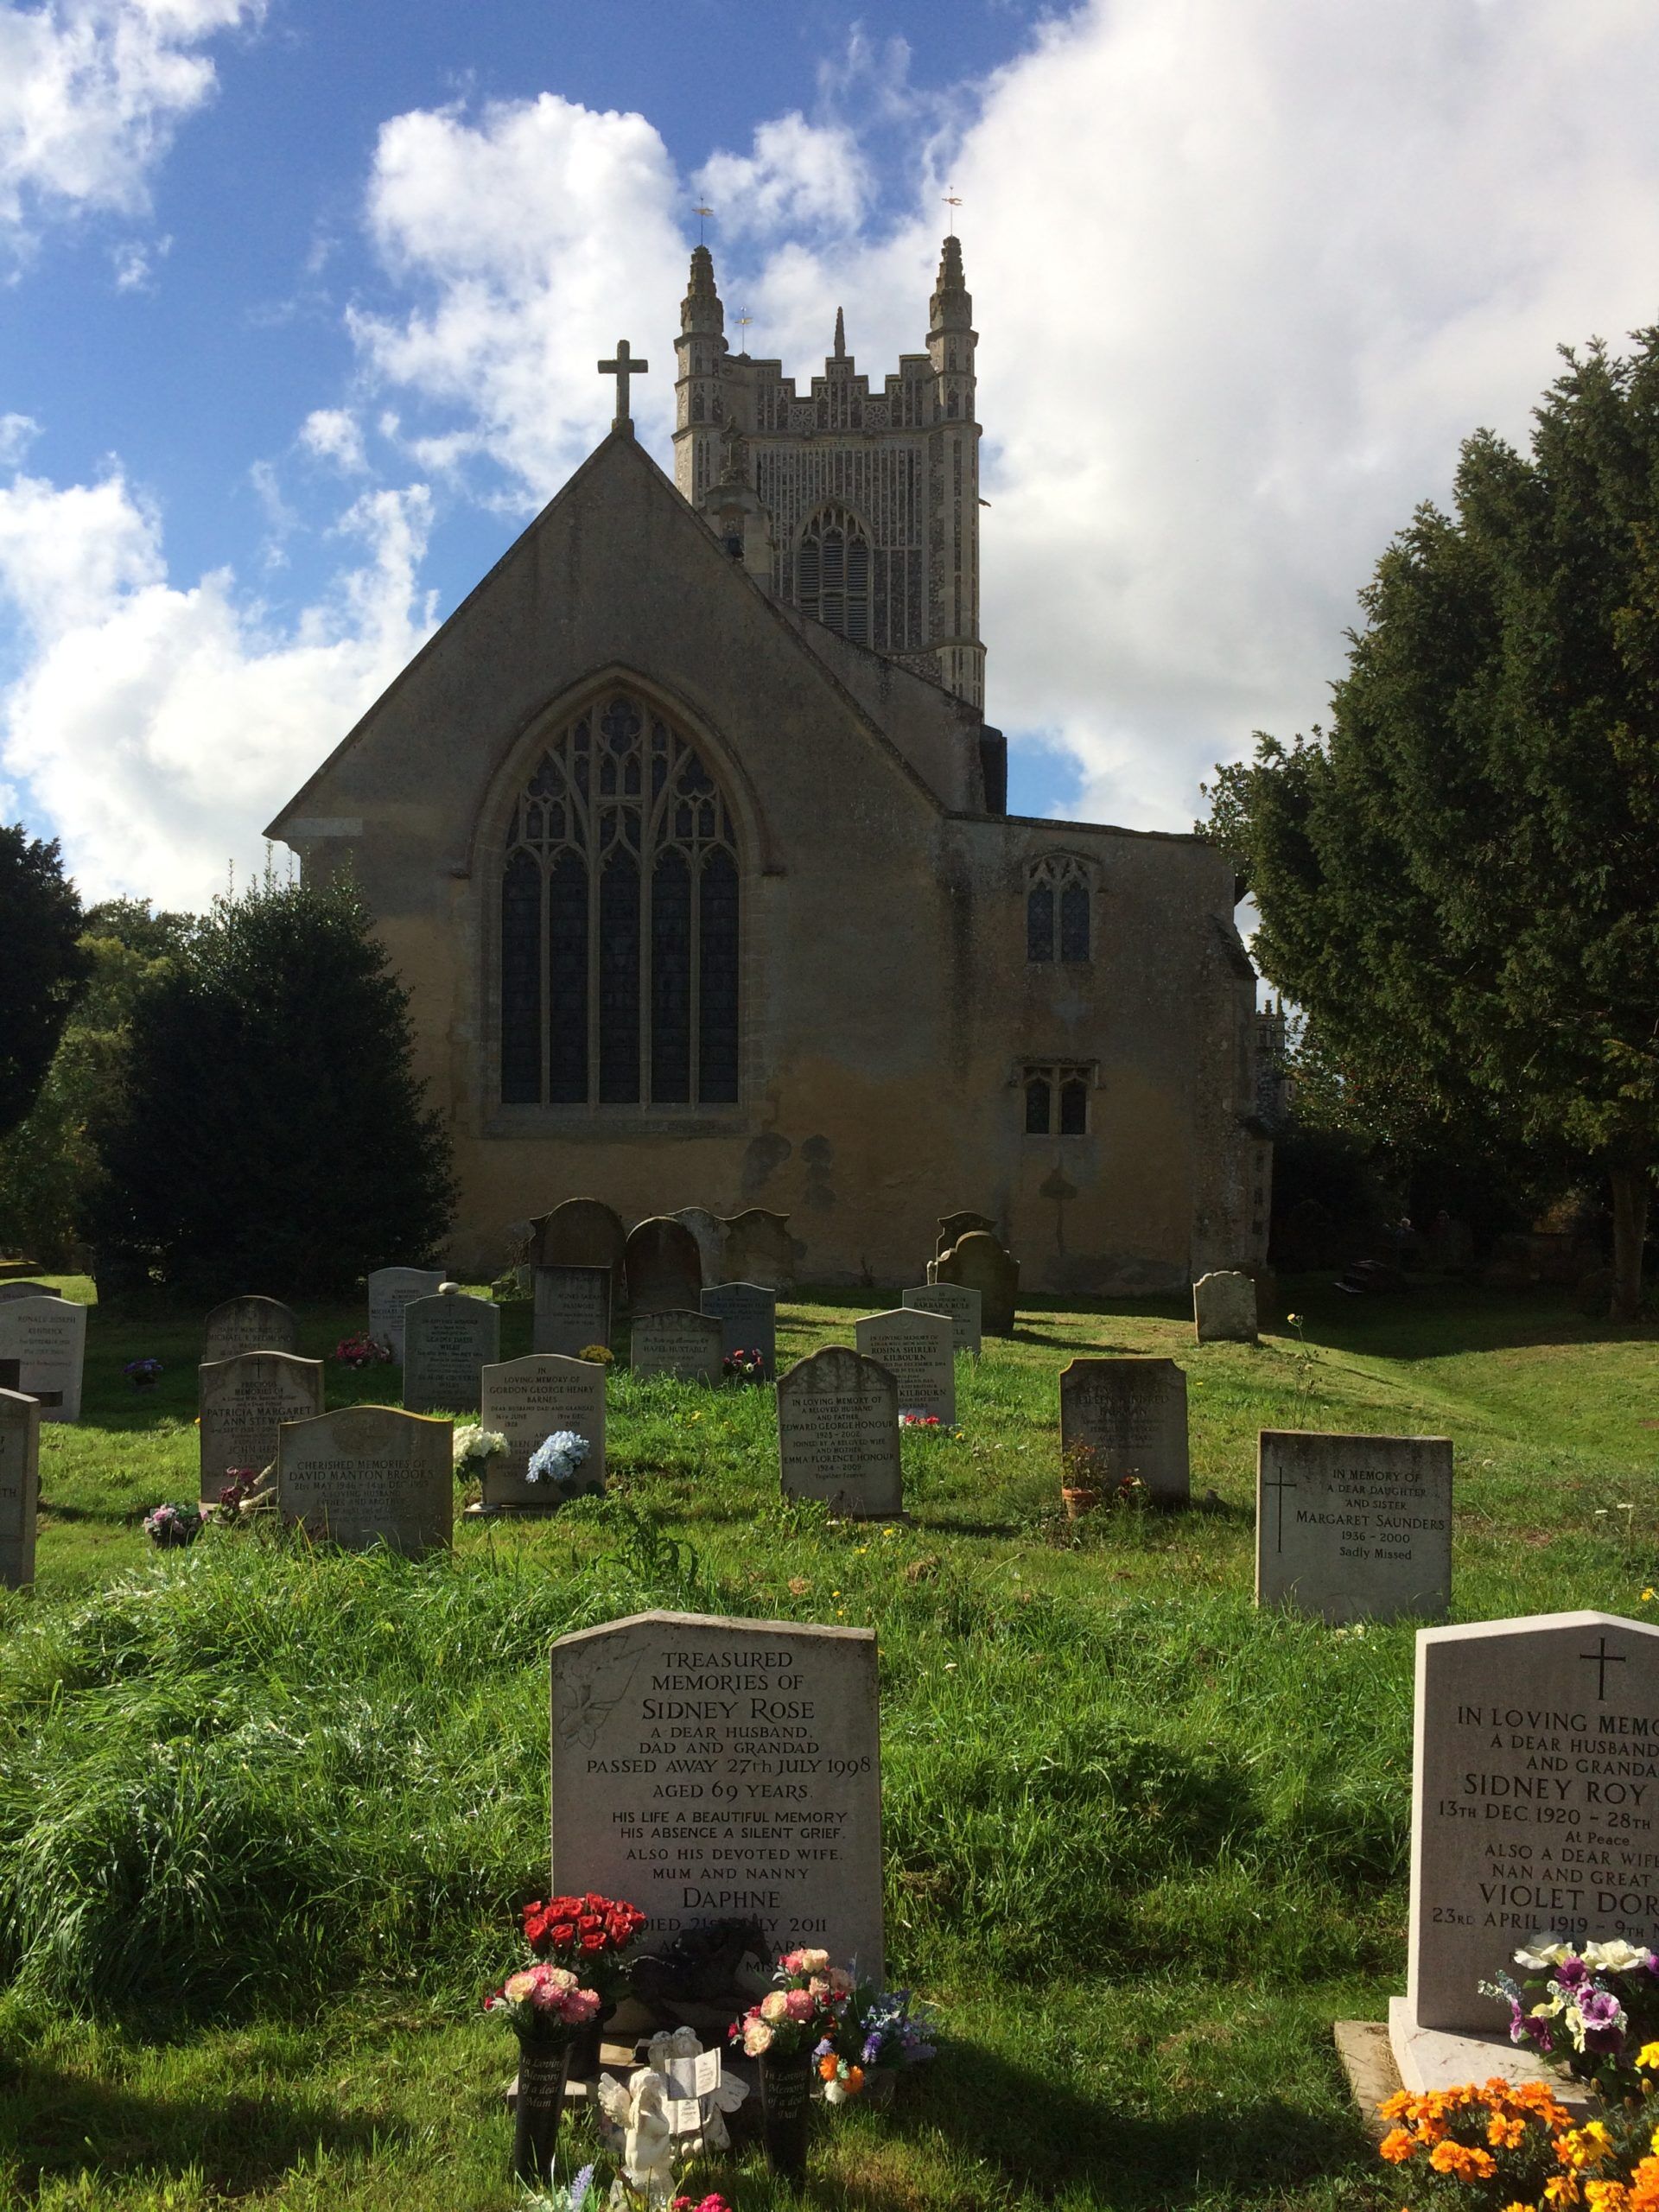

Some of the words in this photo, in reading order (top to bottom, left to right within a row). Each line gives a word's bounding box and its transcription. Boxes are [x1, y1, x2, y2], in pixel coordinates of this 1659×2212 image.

[207, 1408, 252, 1417] PATRICIA
[257, 1406, 311, 1415] MARGARET
[297, 1460, 353, 1471] CHERISHED
[358, 1460, 410, 1469] MEMORIES
[289, 1471, 326, 1481] DAVID
[330, 1470, 383, 1480] MANTON
[1333, 1469, 1344, 1479] IN
[1350, 1471, 1401, 1482] MEMORY
[1405, 1472, 1421, 1483] OF
[1338, 1484, 1366, 1494] DEAR
[1370, 1486, 1426, 1497] DAUGHTER
[1346, 1499, 1370, 1508] AND
[1372, 1500, 1407, 1510] SISTER
[1296, 1510, 1370, 1526] MARGARET
[1376, 1515, 1445, 1530] SAUNDERS
[1342, 1530, 1365, 1541] 1936
[1380, 1533, 1410, 1543] 2000
[1339, 1547, 1370, 1560] Sadly
[1375, 1548, 1412, 1560] Missed
[662, 1652, 792, 1672] TREASURED
[652, 1675, 769, 1695] MEMORIES
[778, 1675, 804, 1690] OF
[642, 1699, 739, 1720] SIDNEY
[750, 1698, 814, 1724] ROSE
[1458, 1706, 1481, 1726] IN
[1491, 1708, 1587, 1732] LOVING
[651, 1726, 662, 1738] A
[671, 1726, 719, 1741] DEAR
[1490, 1733, 1503, 1749] A
[1511, 1735, 1561, 1751] DEAR
[639, 1742, 677, 1754] DAD
[685, 1742, 723, 1754] AND
[734, 1742, 819, 1758] GRANDAD
[587, 1759, 657, 1774] PASSED
[665, 1759, 719, 1774] AWAY
[774, 1759, 822, 1777] JULY
[827, 1757, 871, 1778] 1998
[1526, 1755, 1568, 1771] AND
[653, 1784, 703, 1799] AGED
[711, 1780, 738, 1803] 69
[1464, 1773, 1572, 1801] SIDNEY
[1586, 1781, 1649, 1806] ROY
[612, 1812, 635, 1823] HIS
[641, 1812, 670, 1823] LIFE
[676, 1812, 686, 1823] A
[692, 1812, 769, 1823] BEAUTIFUL
[774, 1812, 848, 1823] MEMORY
[1440, 1800, 1476, 1818] 13TH
[1536, 1807, 1580, 1825] 1920
[1607, 1811, 1650, 1829] 28TH
[620, 1827, 643, 1839] HIS
[651, 1827, 717, 1839] ABSENCE
[723, 1827, 734, 1839] A
[741, 1827, 793, 1839] SILENT
[1565, 1830, 1582, 1843] At
[1588, 1832, 1630, 1846] Peace
[626, 1849, 669, 1860] ALSO
[677, 1849, 703, 1860] HIS
[712, 1849, 790, 1860] DEVOTED
[1484, 1843, 1533, 1859] ALSO
[1541, 1847, 1553, 1860] A
[1561, 1848, 1611, 1865] DEAR
[652, 1868, 691, 1879] MUM
[700, 1868, 737, 1879] AND
[745, 1868, 810, 1879] NANNY
[1492, 1864, 1533, 1879] NAN
[1541, 1867, 1583, 1883] AND
[1591, 1871, 1652, 1887] GREAT
[683, 1887, 780, 1909] DAPHNE
[1478, 1882, 1585, 1910] VIOLET
[790, 1918, 826, 1932] 2011
[1433, 1907, 1475, 1925] 23RD
[1484, 1911, 1541, 1929] APRIL
[1550, 1915, 1588, 1933] 1919
[1614, 1920, 1643, 1937] 9TH
[772, 1941, 807, 1953] ARS
[523, 2056, 531, 2065] In
[532, 2058, 563, 2071] Loving
[524, 2069, 560, 2085] Memory
[766, 2069, 774, 2080] In
[539, 2084, 559, 2094] dear
[769, 2082, 805, 2094] Memory
[525, 2097, 551, 2107] Mum
